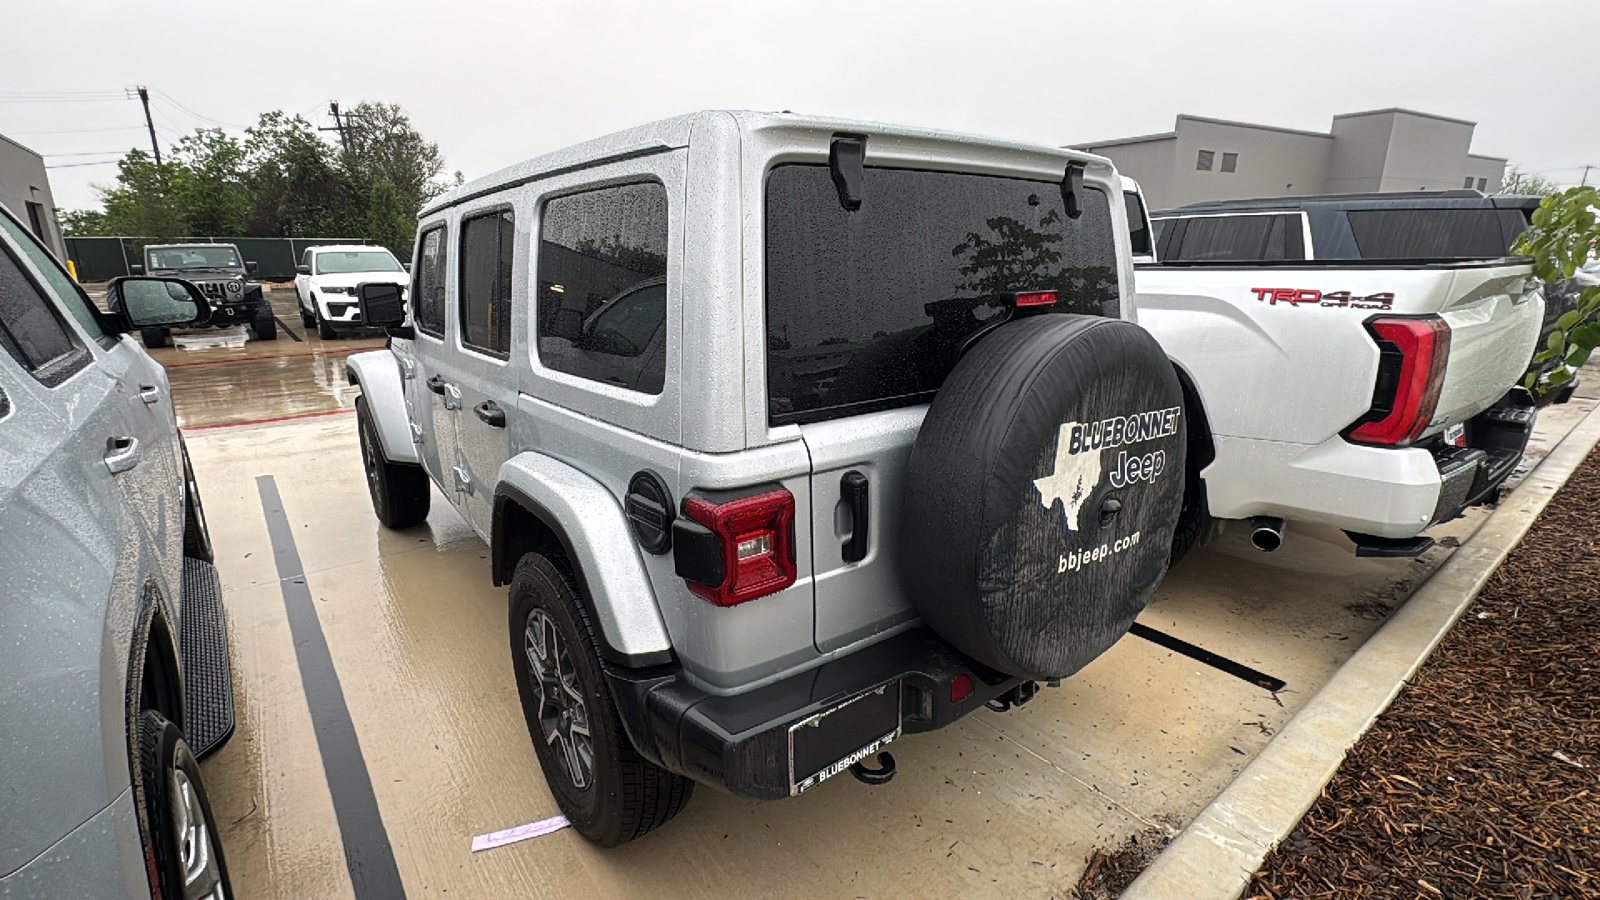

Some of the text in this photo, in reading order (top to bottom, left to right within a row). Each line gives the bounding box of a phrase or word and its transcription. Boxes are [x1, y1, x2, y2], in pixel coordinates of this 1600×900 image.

[1251, 287, 1322, 307] TRD
[1068, 406, 1181, 455] BLUEBONNET
[1110, 450, 1165, 488] Jeep
[1058, 531, 1140, 573] bbjeep.com
[820, 741, 880, 782] BLUEBONNET
